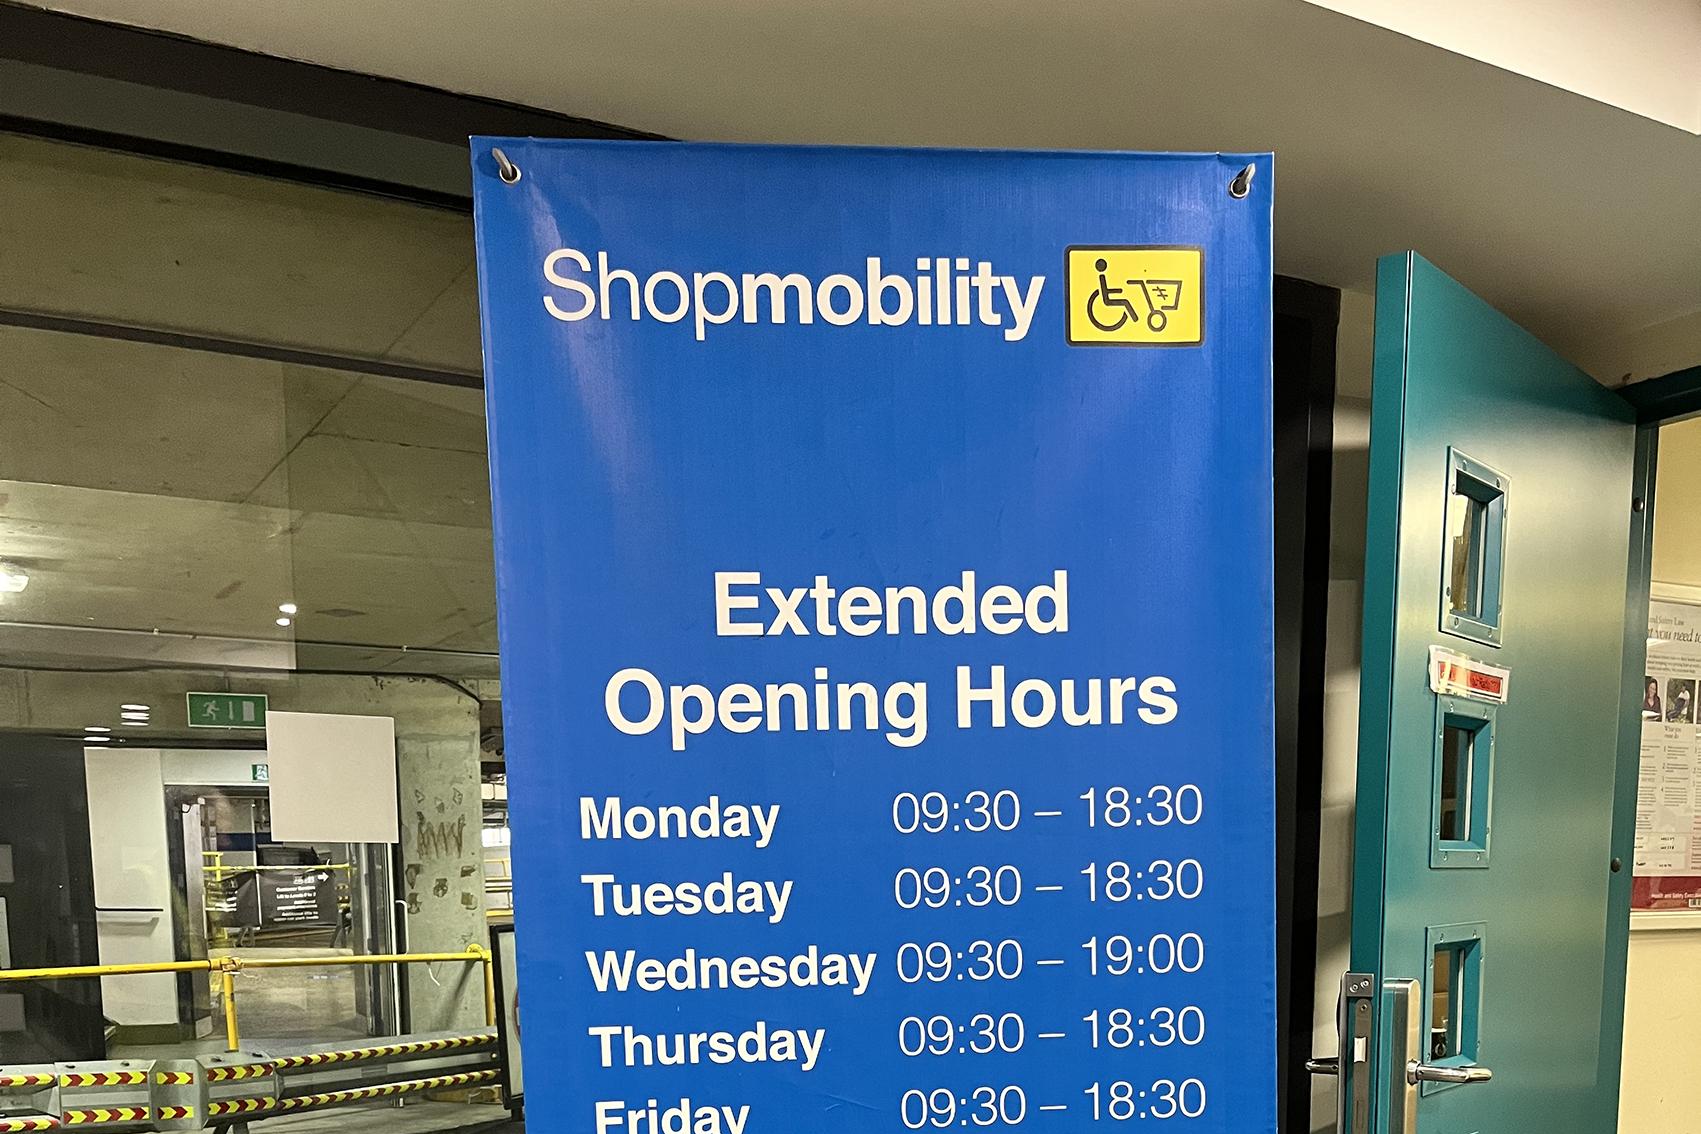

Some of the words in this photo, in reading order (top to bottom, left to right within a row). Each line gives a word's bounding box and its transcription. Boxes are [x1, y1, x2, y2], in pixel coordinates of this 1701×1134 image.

[544, 249, 1045, 341] Shopmobility
[715, 570, 1068, 636] Extended
[1673, 628, 1693, 642] need
[605, 668, 927, 750] Opening
[957, 666, 1177, 728] Hours
[580, 796, 780, 847] Monday
[893, 790, 1019, 833] 09:30
[1080, 785, 1202, 827] 18:30
[581, 872, 793, 923] Tuesday
[895, 866, 1021, 908] 09:30
[1081, 859, 1203, 901] 18:30
[585, 946, 876, 995] Wednesday
[897, 940, 1022, 982] 09:30
[1082, 933, 1203, 975] 19:00
[589, 1022, 825, 1070] Thursday
[899, 1013, 1024, 1055] 09:30
[1084, 1006, 1204, 1047] 18:30
[902, 1086, 1025, 1128] 09:30
[1085, 1079, 1205, 1120] 18:30
